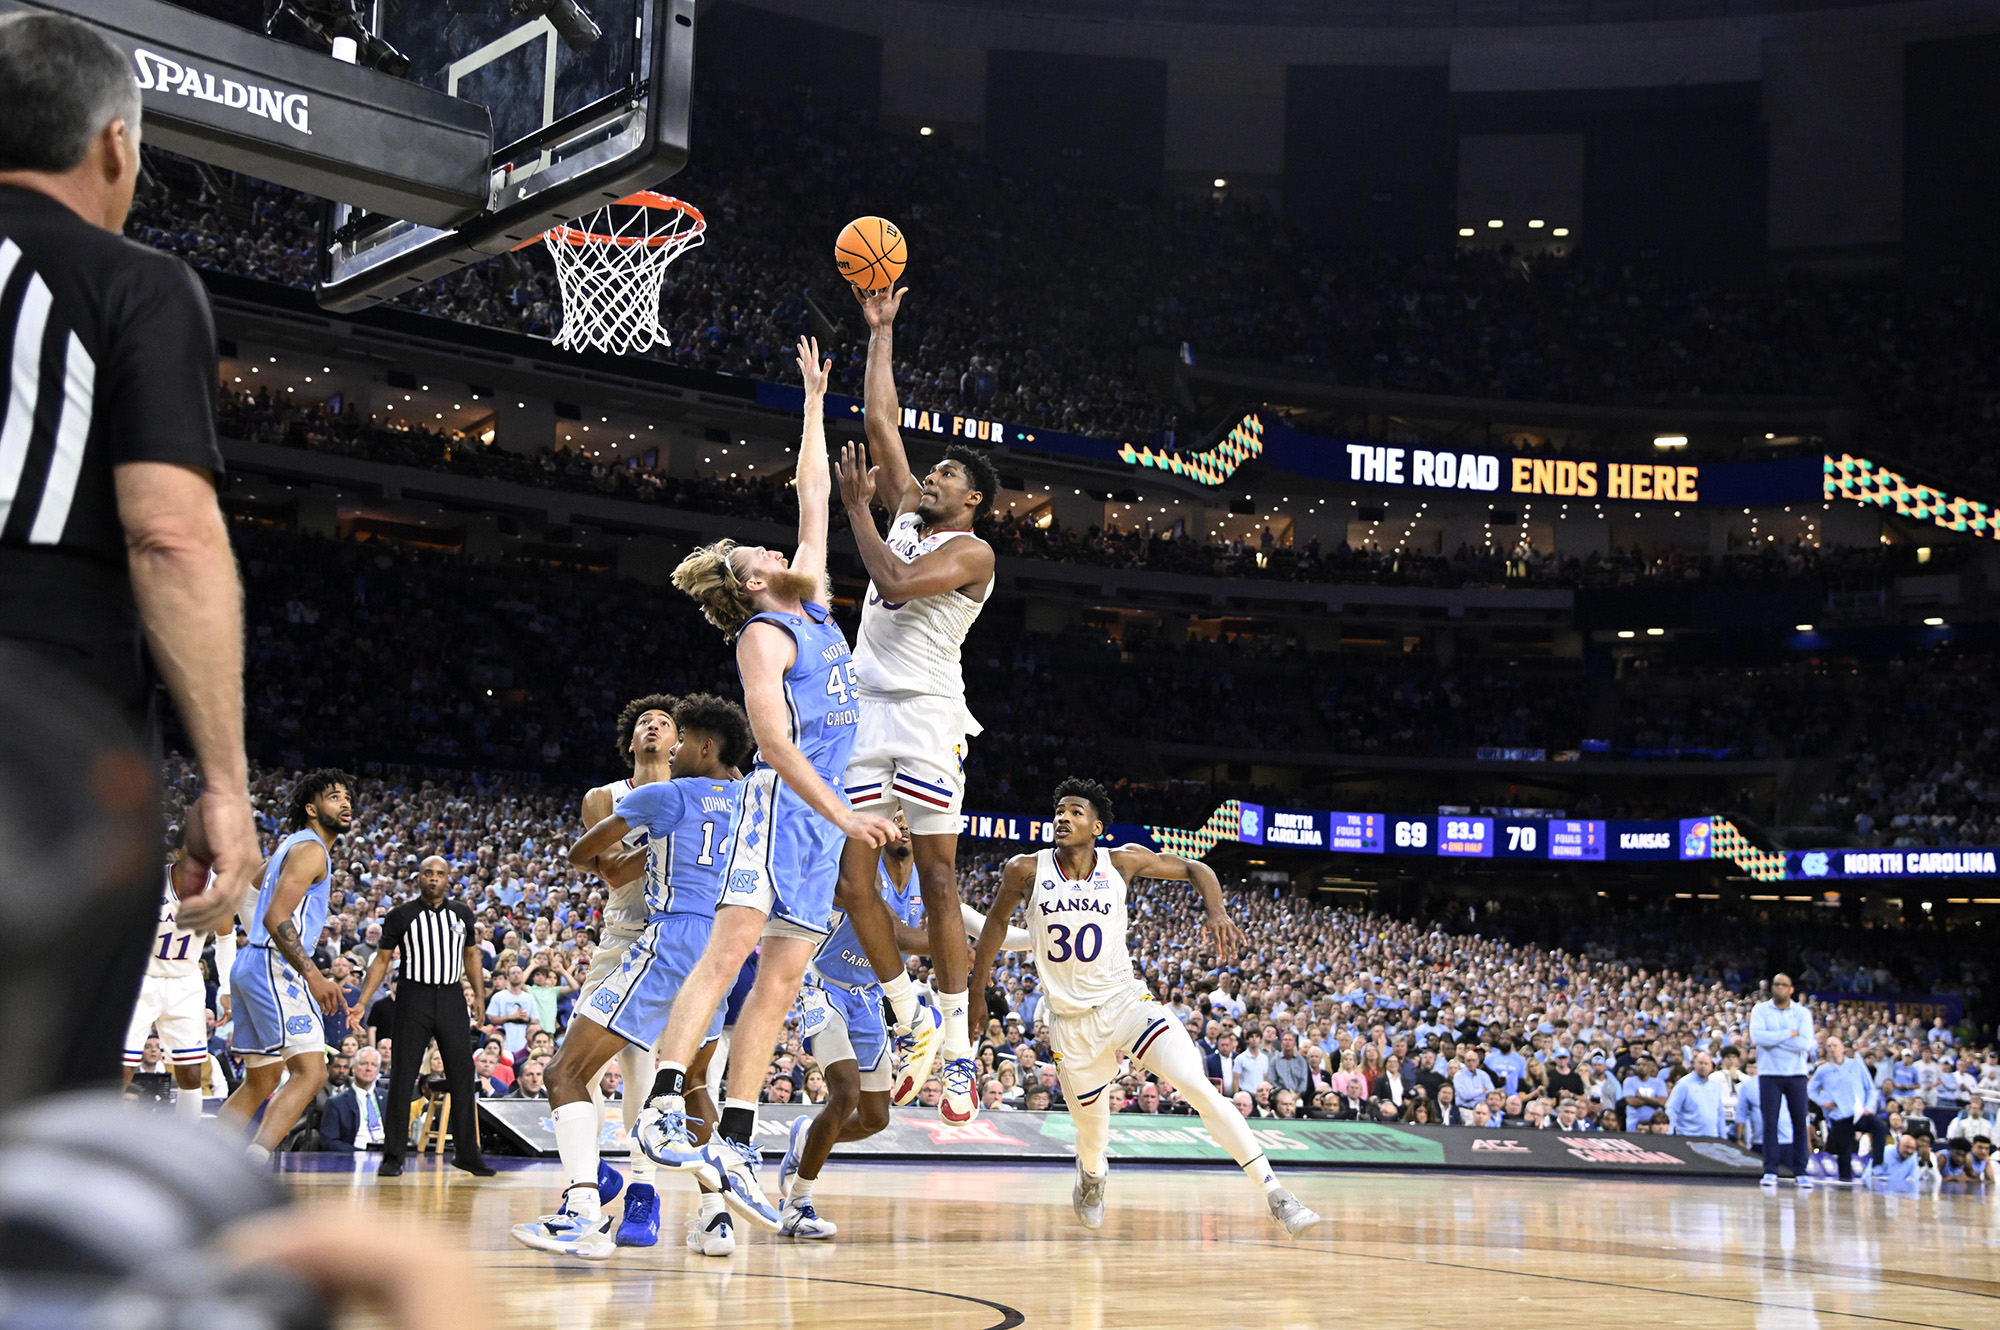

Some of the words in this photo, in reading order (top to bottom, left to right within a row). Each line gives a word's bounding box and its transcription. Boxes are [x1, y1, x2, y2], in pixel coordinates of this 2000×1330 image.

[134, 48, 312, 135] SPALDING
[897, 406, 944, 433] INAL
[952, 416, 1004, 443] FOUR
[1346, 443, 1405, 484] THE
[1412, 450, 1500, 491] ROAD
[1511, 457, 1598, 497] ENDS
[1607, 463, 1699, 502] HERE
[826, 659, 859, 706] 45
[826, 709, 859, 727] CAROL
[960, 814, 1020, 841] FINAL
[1274, 812, 1313, 830] NORTH
[1447, 821, 1485, 840] 23.9
[1267, 826, 1323, 846] CAROLINA
[1395, 821, 1427, 848] 69
[1506, 826, 1536, 851] 70
[1620, 832, 1671, 849] KANSAS
[1844, 853, 1904, 874] NORTH
[1906, 852, 1997, 874] CAROLINA
[1039, 898, 1112, 916] KANSAS
[155, 931, 192, 961] 11
[1047, 923, 1103, 963] 30
[841, 949, 871, 968] CARO
[1294, 1130, 1419, 1152] HERE
[1472, 1138, 1533, 1153] ACC
